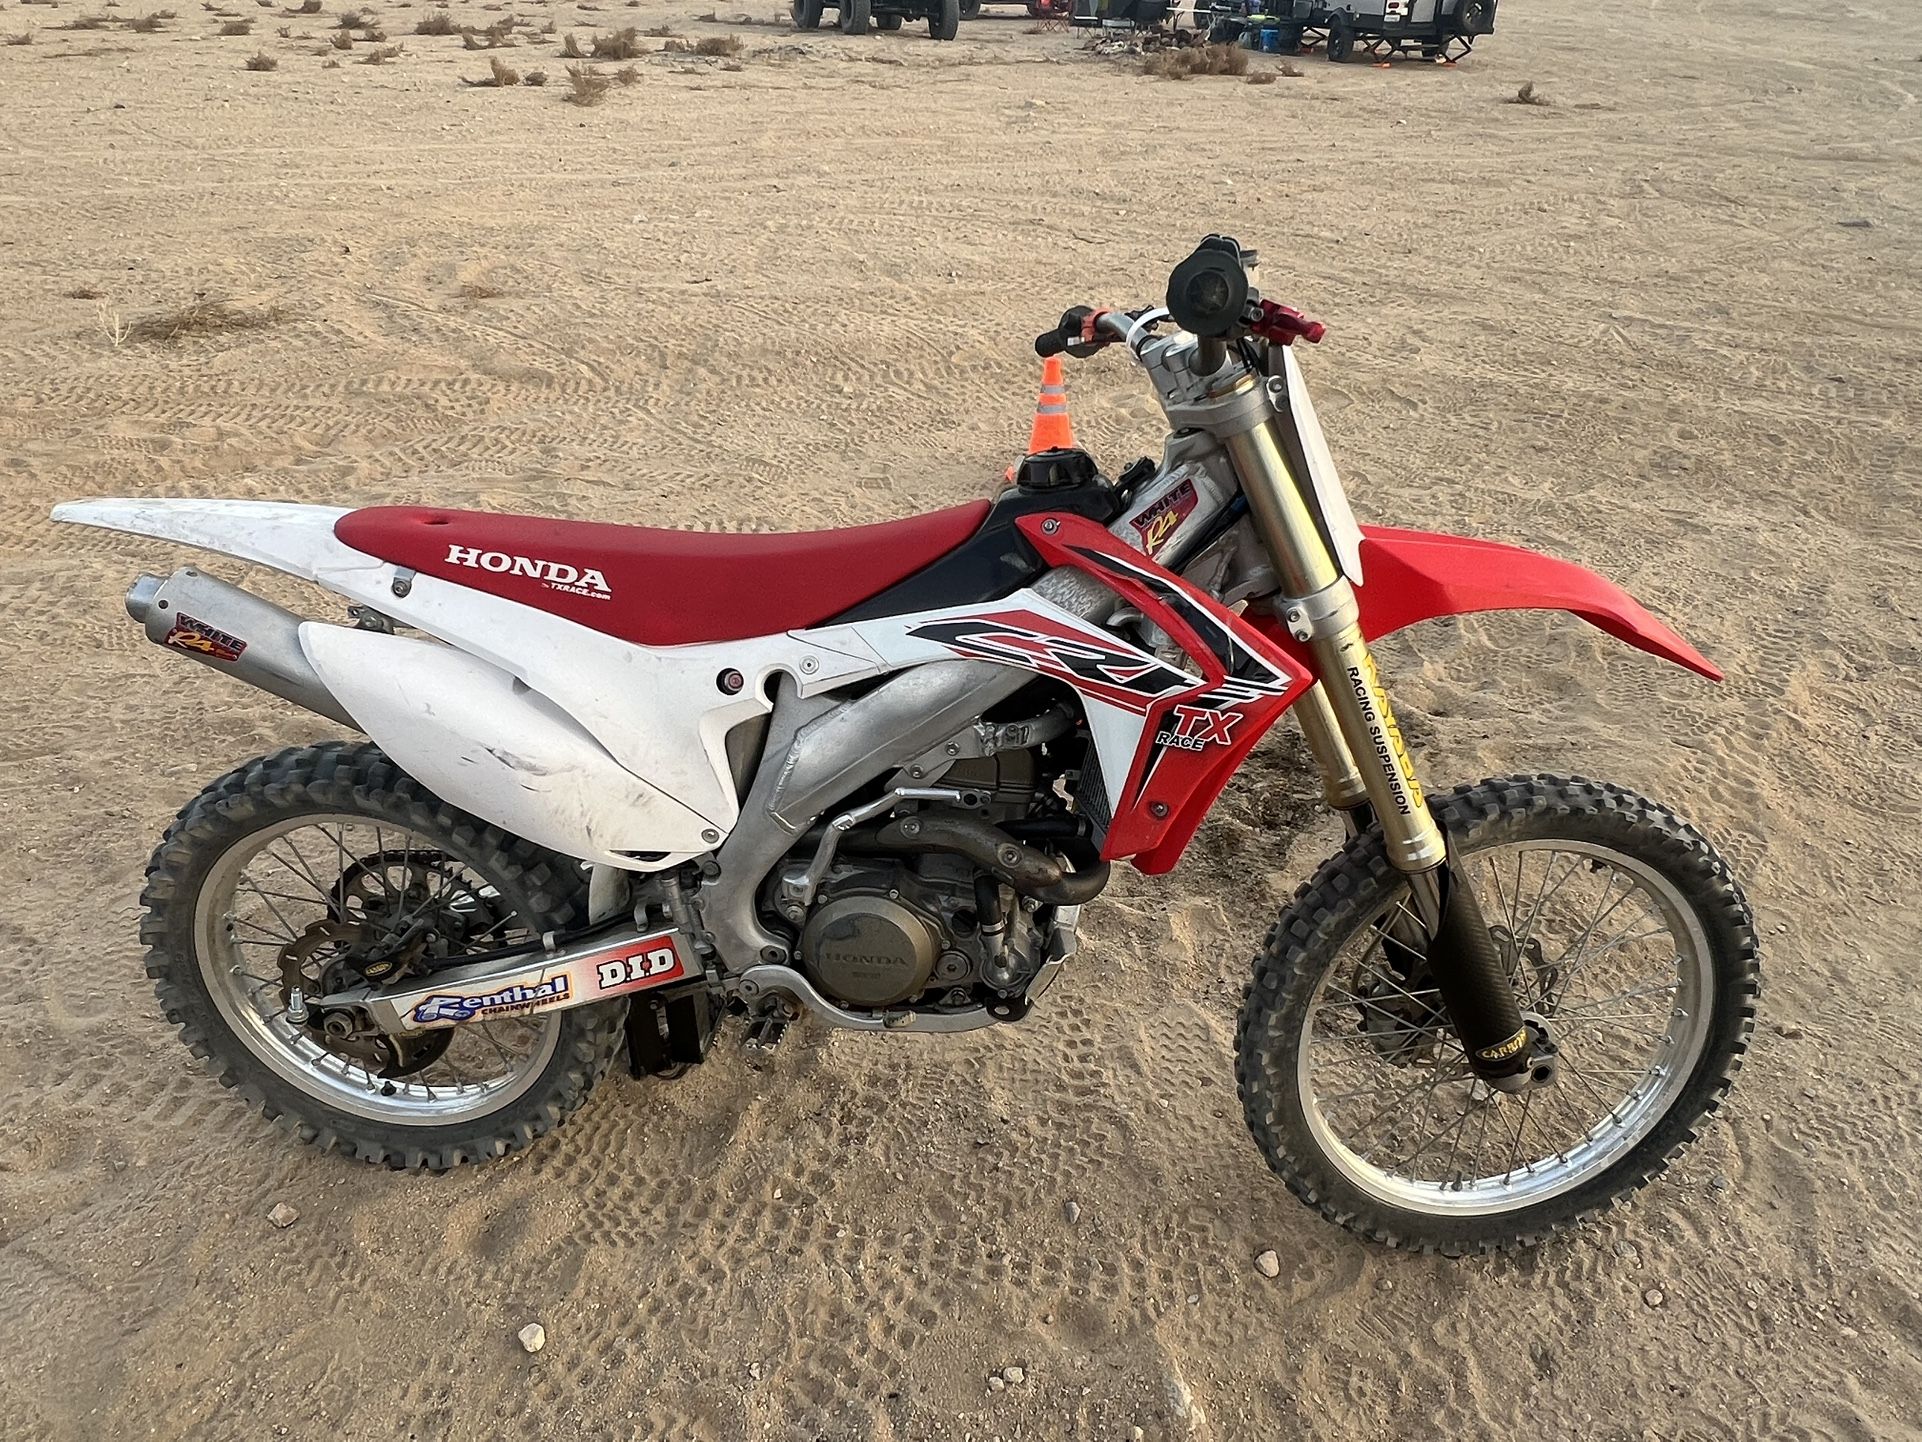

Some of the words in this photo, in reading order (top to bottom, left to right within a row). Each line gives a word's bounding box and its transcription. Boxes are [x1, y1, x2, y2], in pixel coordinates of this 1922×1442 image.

[1131, 481, 1193, 528] WHITE
[444, 544, 612, 593] HONDA
[551, 582, 611, 600] TXRACE.com
[178, 615, 243, 653] WHITE
[1155, 730, 1206, 752] RACE
[1173, 704, 1244, 745] TX
[1347, 666, 1376, 723] RACING
[1369, 725, 1411, 816] SUSPENSION
[825, 952, 909, 967] HONDA
[413, 975, 569, 1022] Renthal
[1481, 1028, 1528, 1060] CARBON
